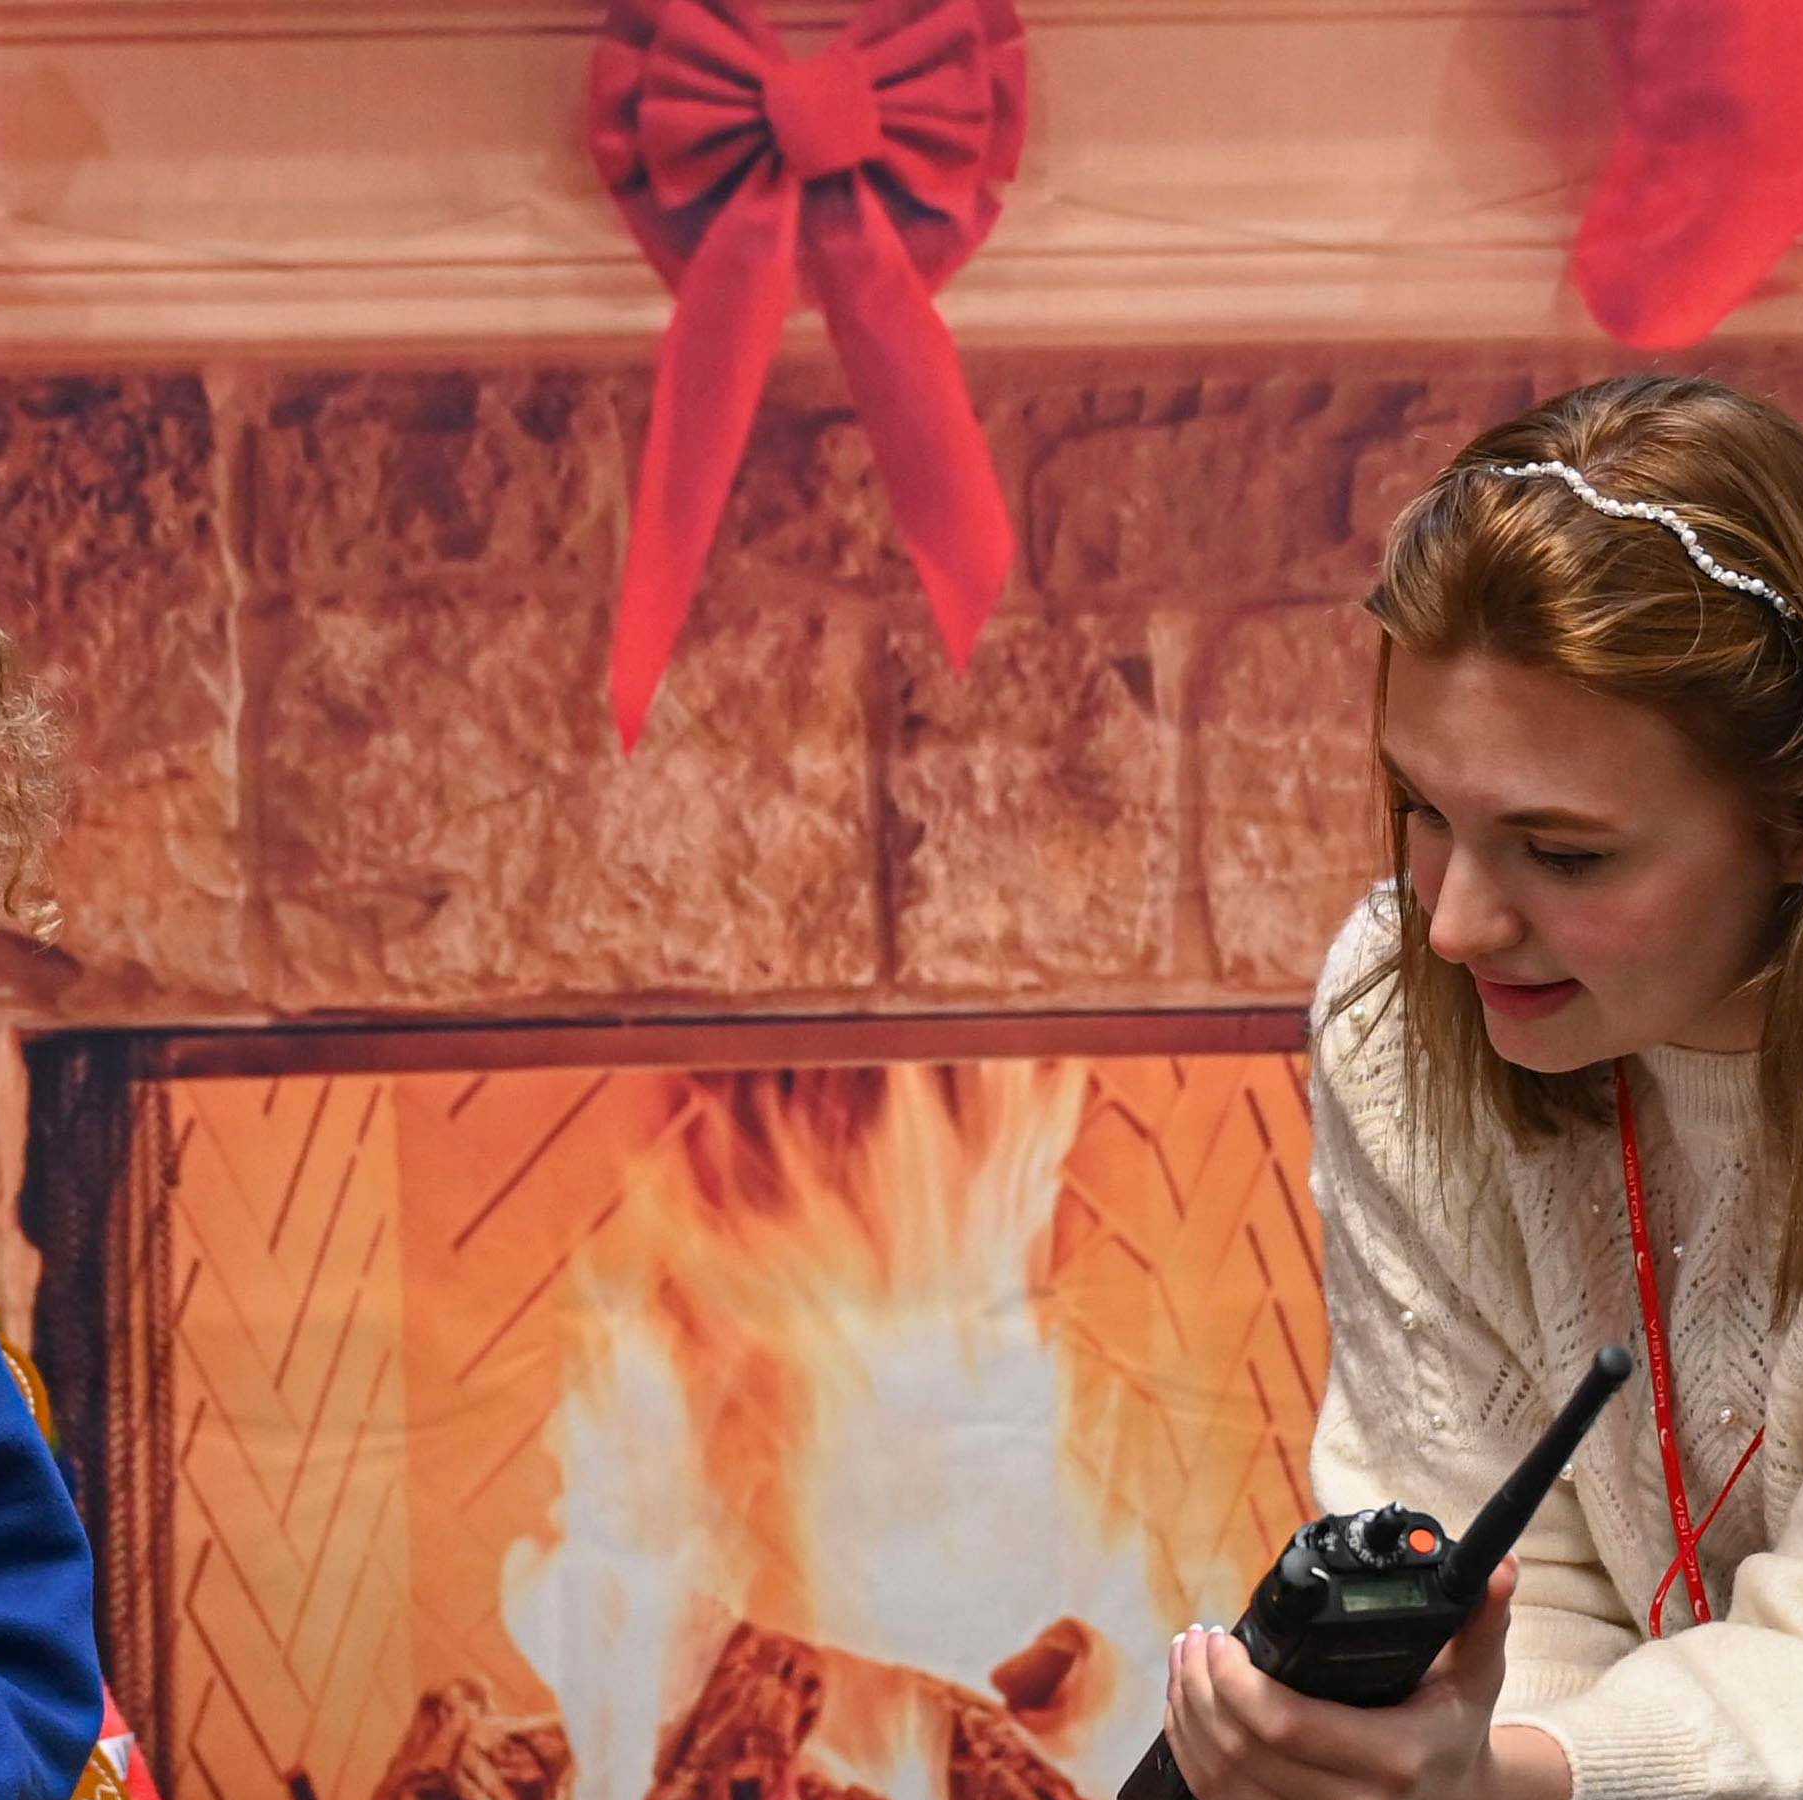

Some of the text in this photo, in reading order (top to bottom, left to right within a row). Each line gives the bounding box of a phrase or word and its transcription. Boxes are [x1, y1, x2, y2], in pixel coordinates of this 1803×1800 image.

[1624, 1144, 1643, 1234] VISITOR
[1649, 1318, 1666, 1408] VISITOR
[1674, 1495, 1698, 1582] VISIOR
